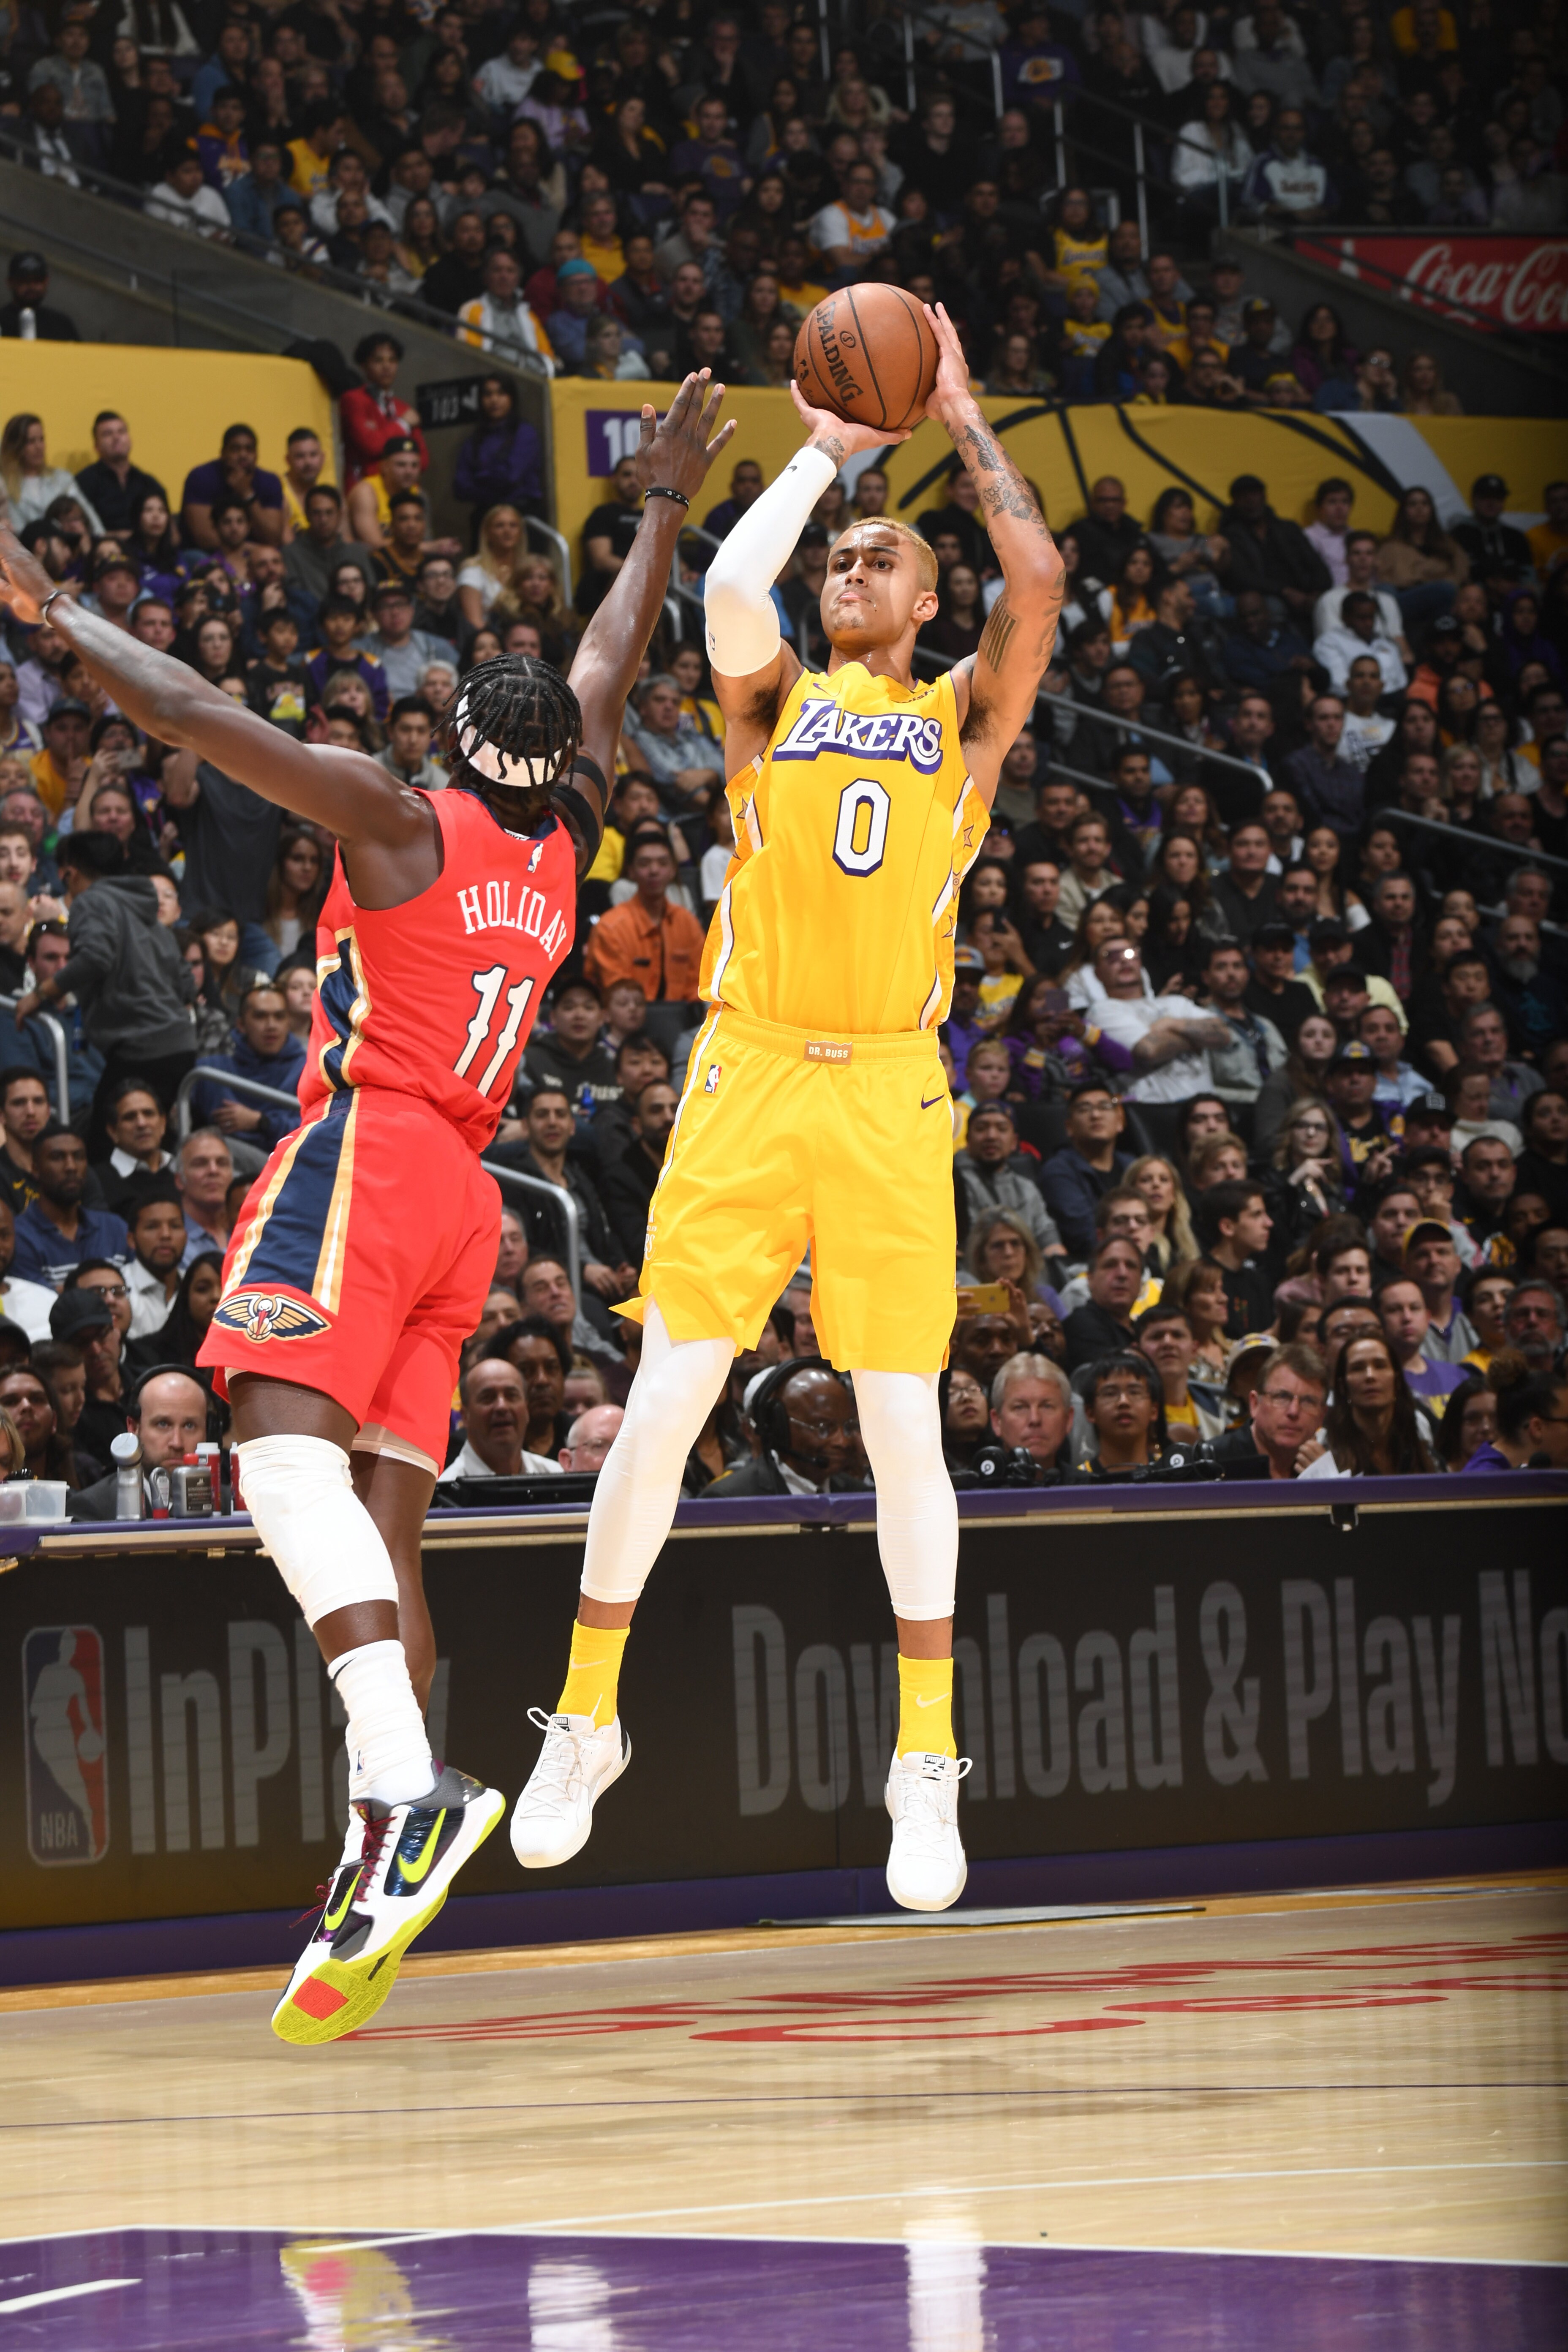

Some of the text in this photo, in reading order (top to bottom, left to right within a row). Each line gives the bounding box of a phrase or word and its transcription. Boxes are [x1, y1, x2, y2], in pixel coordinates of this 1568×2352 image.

[817, 301, 864, 406] SPALDING
[772, 698, 943, 775] LAKERS
[833, 778, 891, 877] 0
[457, 880, 567, 961] HOLIDAY
[453, 964, 536, 1097] 11
[808, 1046, 848, 1058] DR. BUSS
[1200, 1579, 1268, 1786] &
[1281, 1576, 1461, 1808] Play
[41, 1812, 78, 1849] NBA
